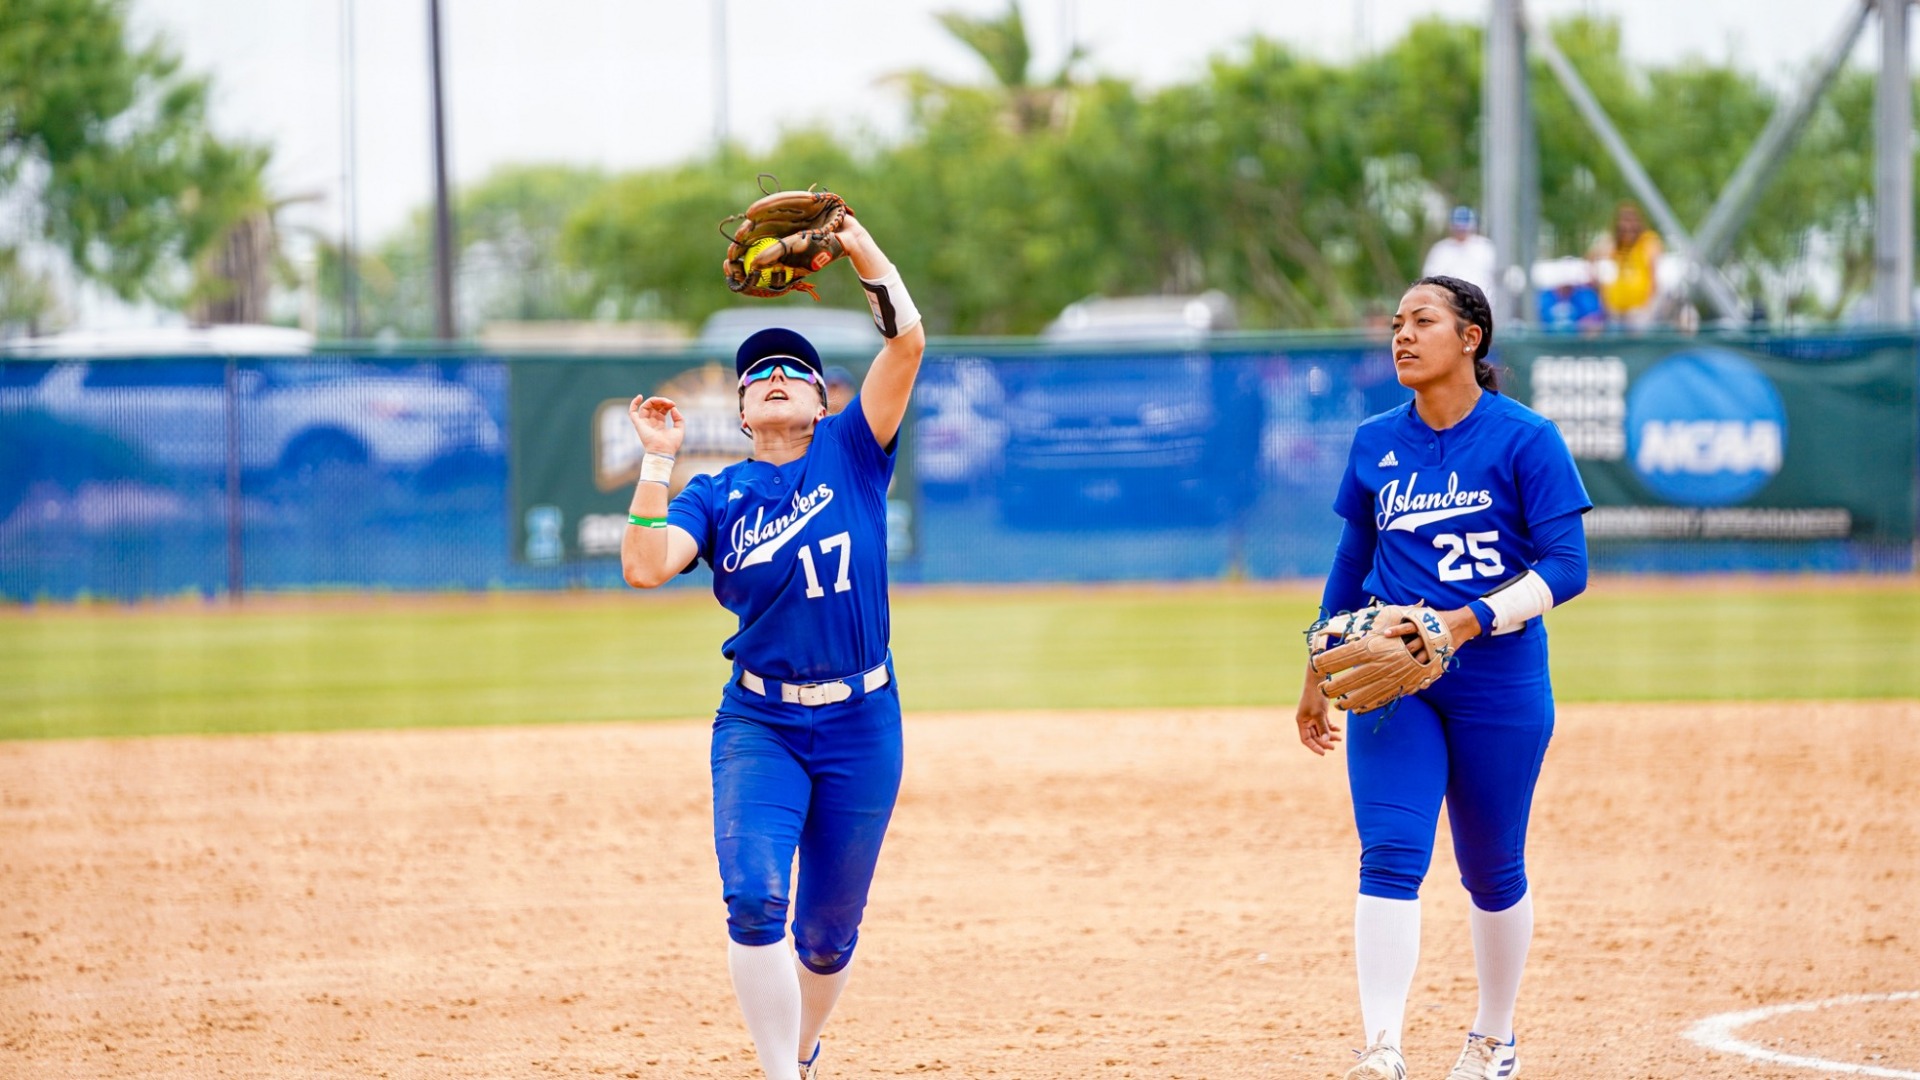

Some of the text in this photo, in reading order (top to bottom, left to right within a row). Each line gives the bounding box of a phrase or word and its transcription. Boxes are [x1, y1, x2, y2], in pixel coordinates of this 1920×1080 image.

[1636, 419, 1783, 474] NCAA
[723, 483, 834, 573] Islanders
[1376, 471, 1493, 531] Islanders
[797, 531, 851, 598] 17
[1432, 530, 1505, 582] 25
